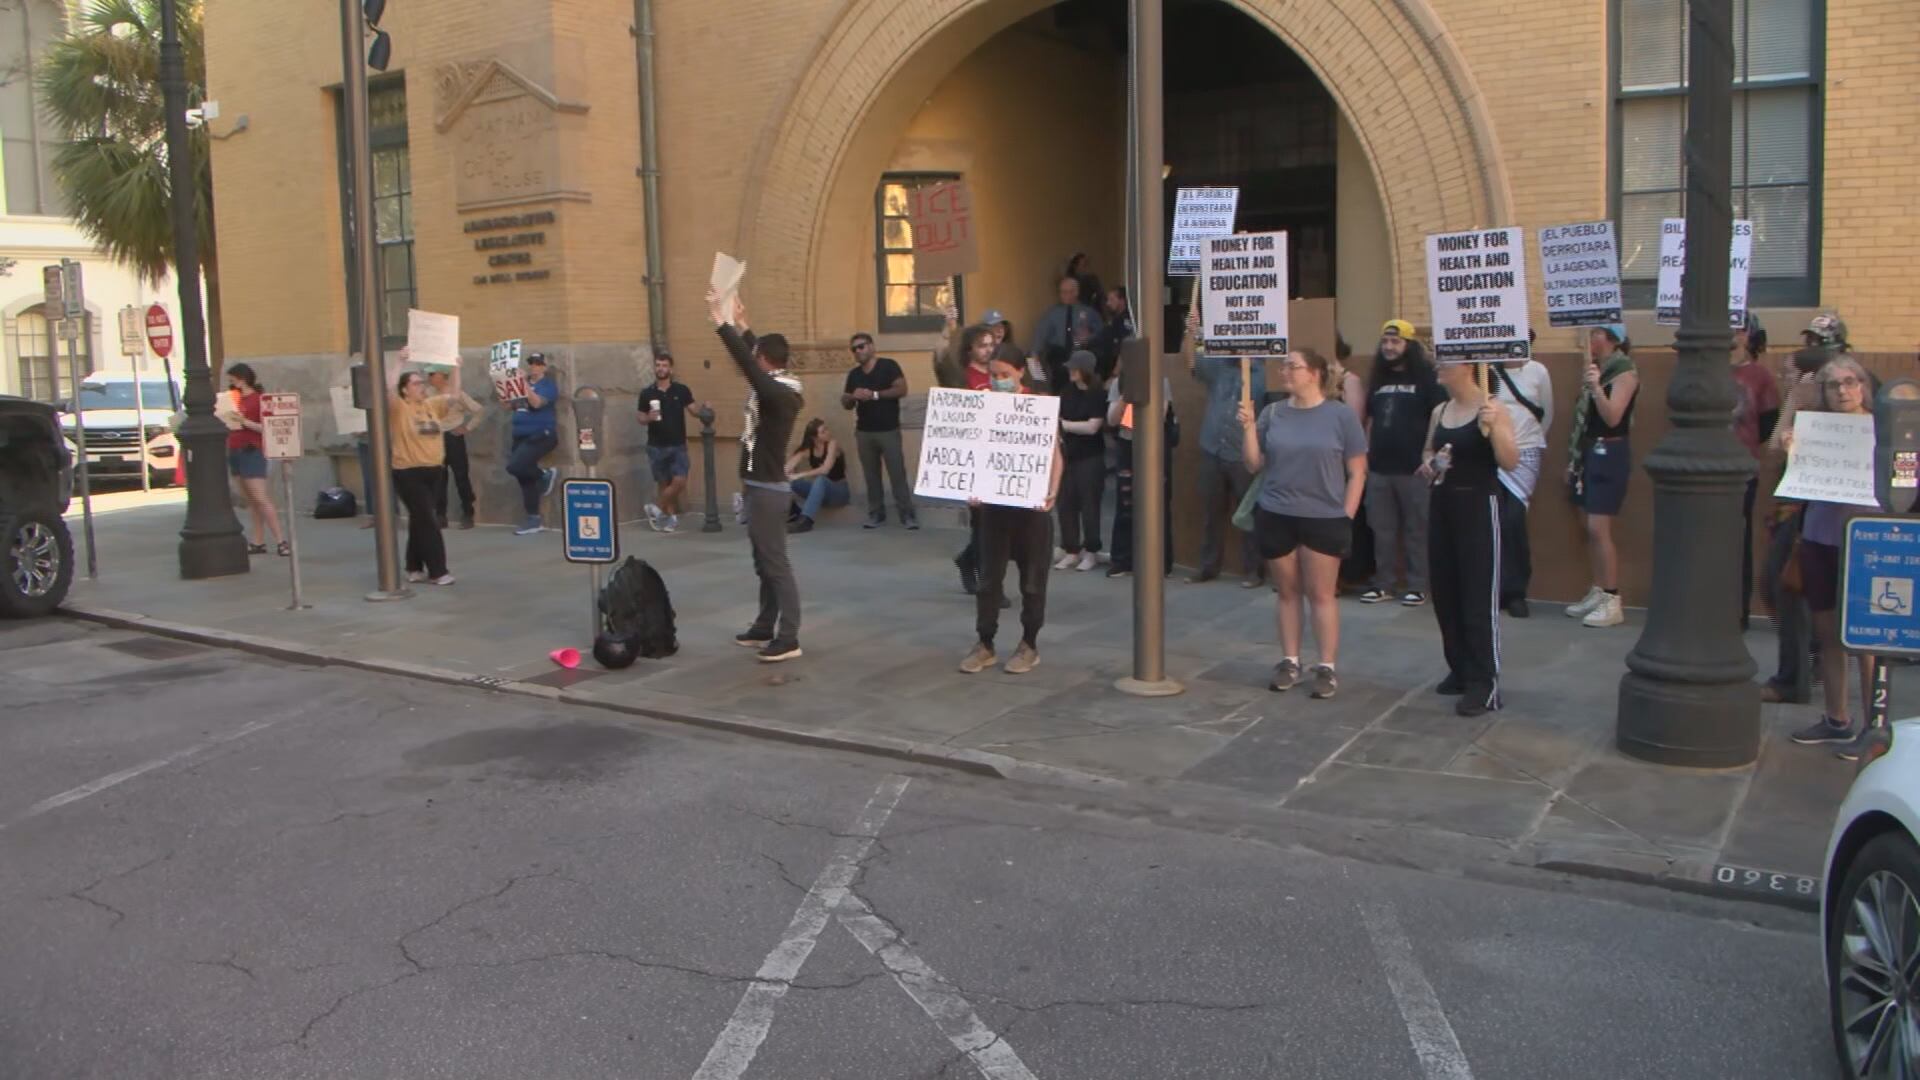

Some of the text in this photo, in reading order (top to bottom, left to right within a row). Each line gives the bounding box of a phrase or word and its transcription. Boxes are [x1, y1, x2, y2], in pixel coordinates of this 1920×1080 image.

[915, 217, 967, 250] OUT
[1561, 223, 1608, 238] PUEBLO
[1211, 237, 1249, 253] MONEY
[1252, 235, 1275, 251] FOR
[1437, 231, 1509, 251] MONEY FOR
[1211, 256, 1250, 272] HEALTH
[1253, 255, 1275, 269] AND
[1440, 251, 1510, 271] HEALTH AND
[1547, 259, 1609, 275] LA AGENDA
[1209, 273, 1278, 292] EDUCATION
[1437, 271, 1515, 293] EDUCATION
[1225, 294, 1265, 308] NOT FOR
[1456, 295, 1501, 310] NOT FOR
[1547, 290, 1618, 307] DE TRUMP!
[1227, 309, 1260, 323] RACIST
[1461, 311, 1497, 325] RACIST
[1213, 323, 1278, 337] DEPORTATION
[1444, 324, 1516, 341] DEPORTATION
[491, 341, 520, 363] ICE
[1013, 397, 1036, 415] WE
[995, 412, 1051, 427] SUPPORT
[987, 429, 1053, 448] IMMIGRANTS!
[985, 451, 1048, 475] ABOLISH
[920, 470, 976, 493] A ICE!
[995, 473, 1033, 499] ICE!
